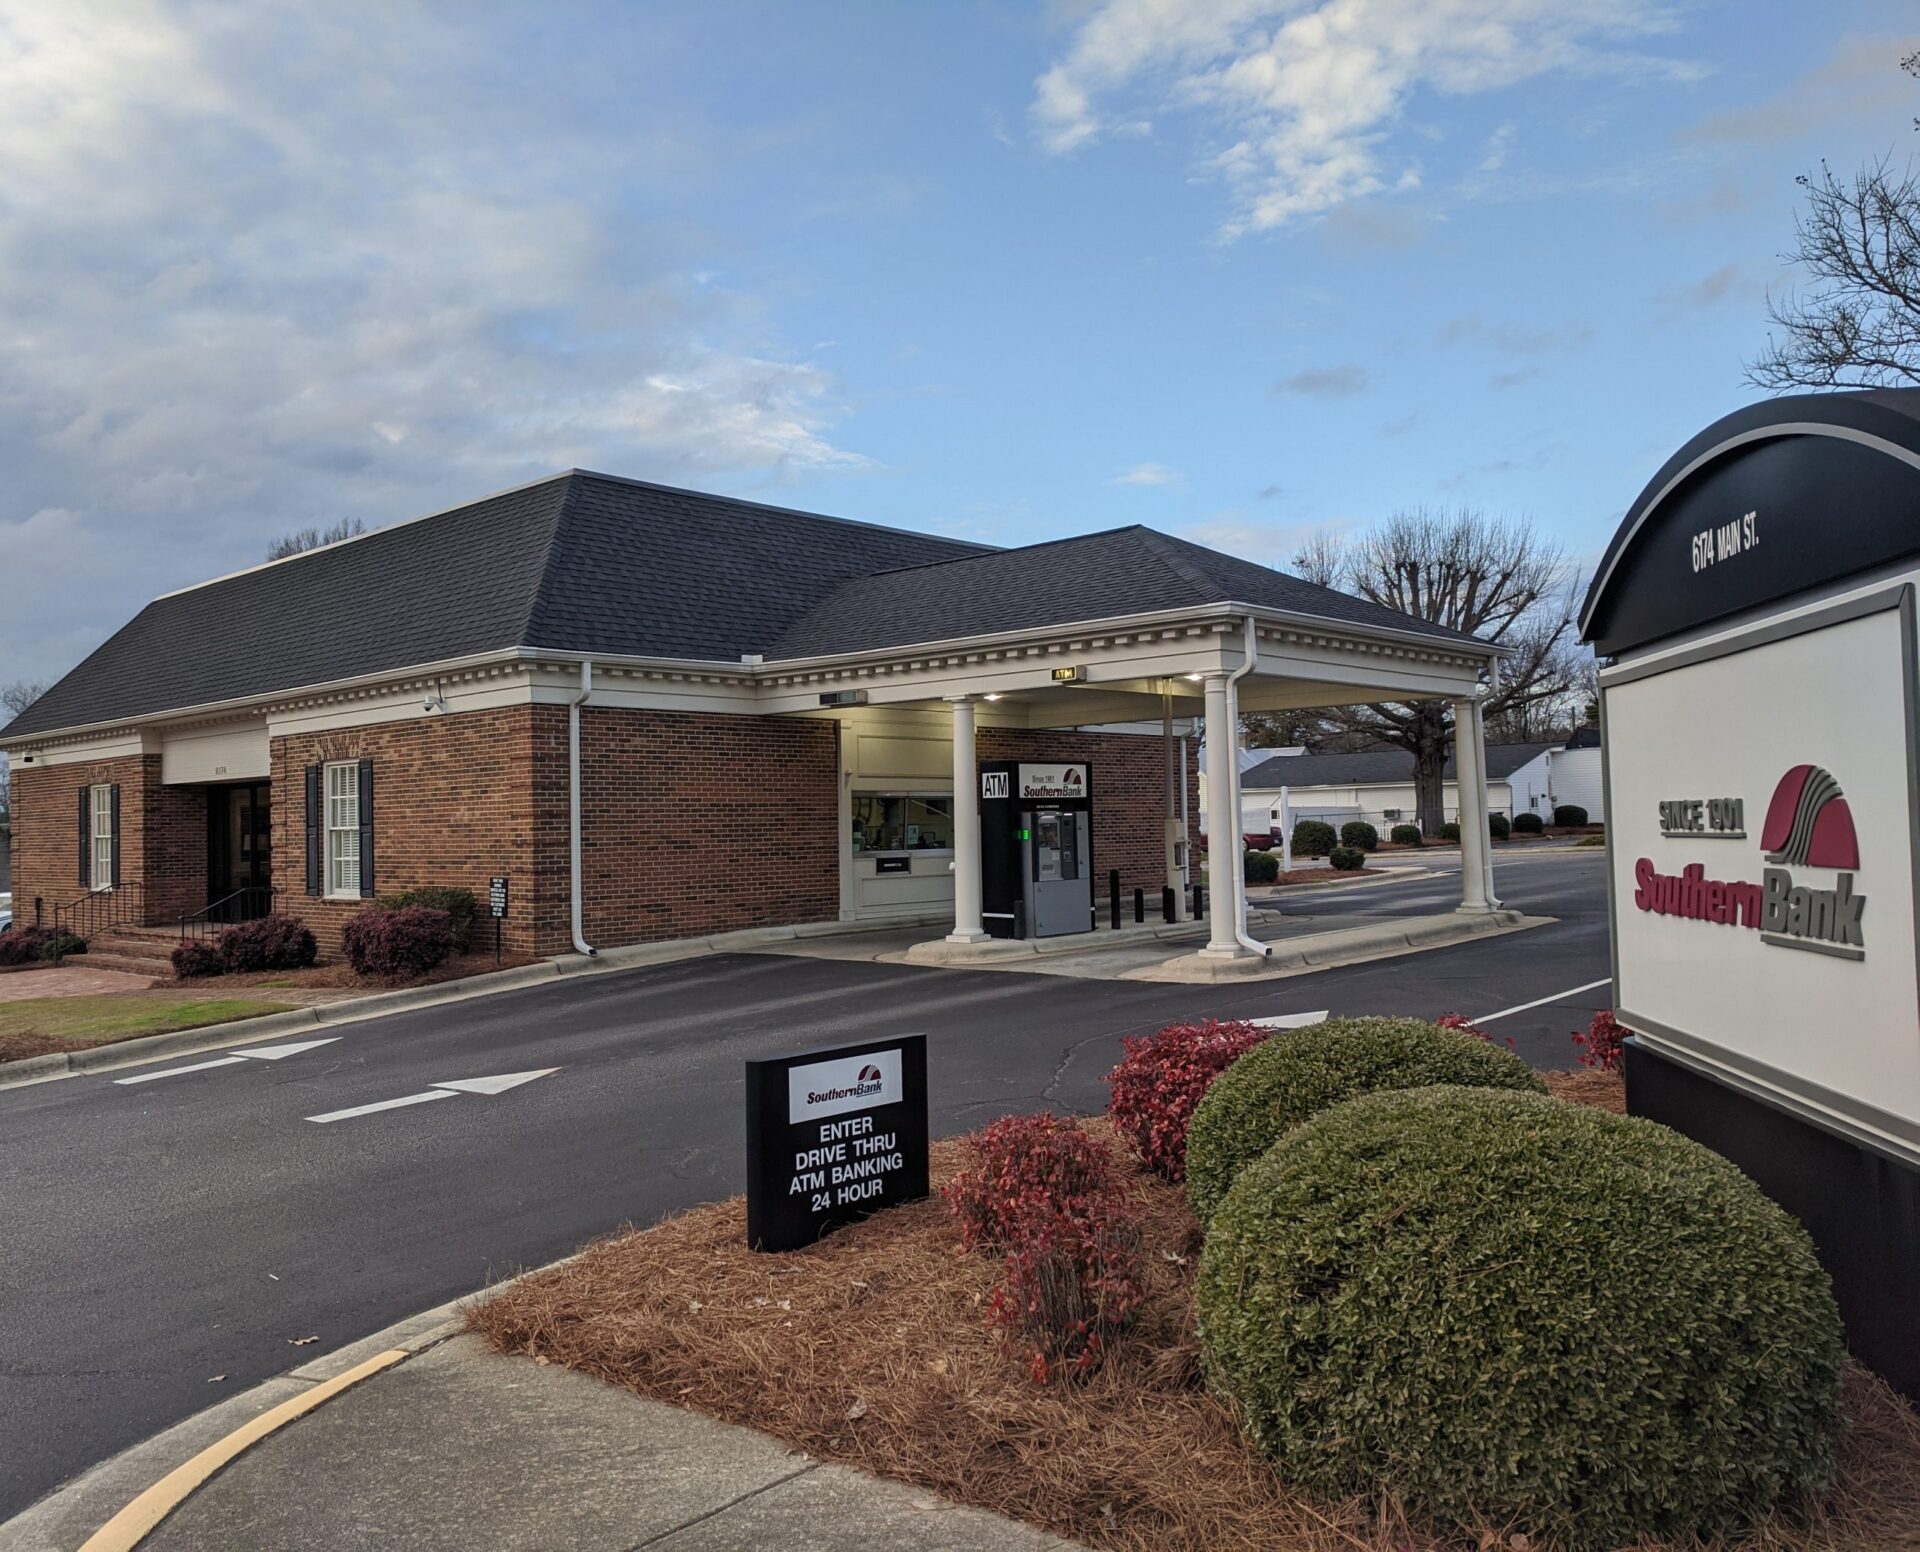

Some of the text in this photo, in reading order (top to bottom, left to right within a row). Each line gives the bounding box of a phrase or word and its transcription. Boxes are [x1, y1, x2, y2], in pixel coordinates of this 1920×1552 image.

[1692, 510, 1759, 573] 6174 MAIN ST.
[1055, 669, 1073, 679] ATM
[984, 774, 1008, 797] ATM
[1659, 798, 1744, 831] SINCE 1901
[1635, 858, 1867, 946] SouthernBank
[807, 1080, 882, 1105] SouthernBank
[820, 1116, 873, 1143] ENTER
[795, 1132, 896, 1171] DRIVE THRU
[789, 1152, 903, 1195] ATM BANKING
[811, 1178, 883, 1212] 24 HOUR
